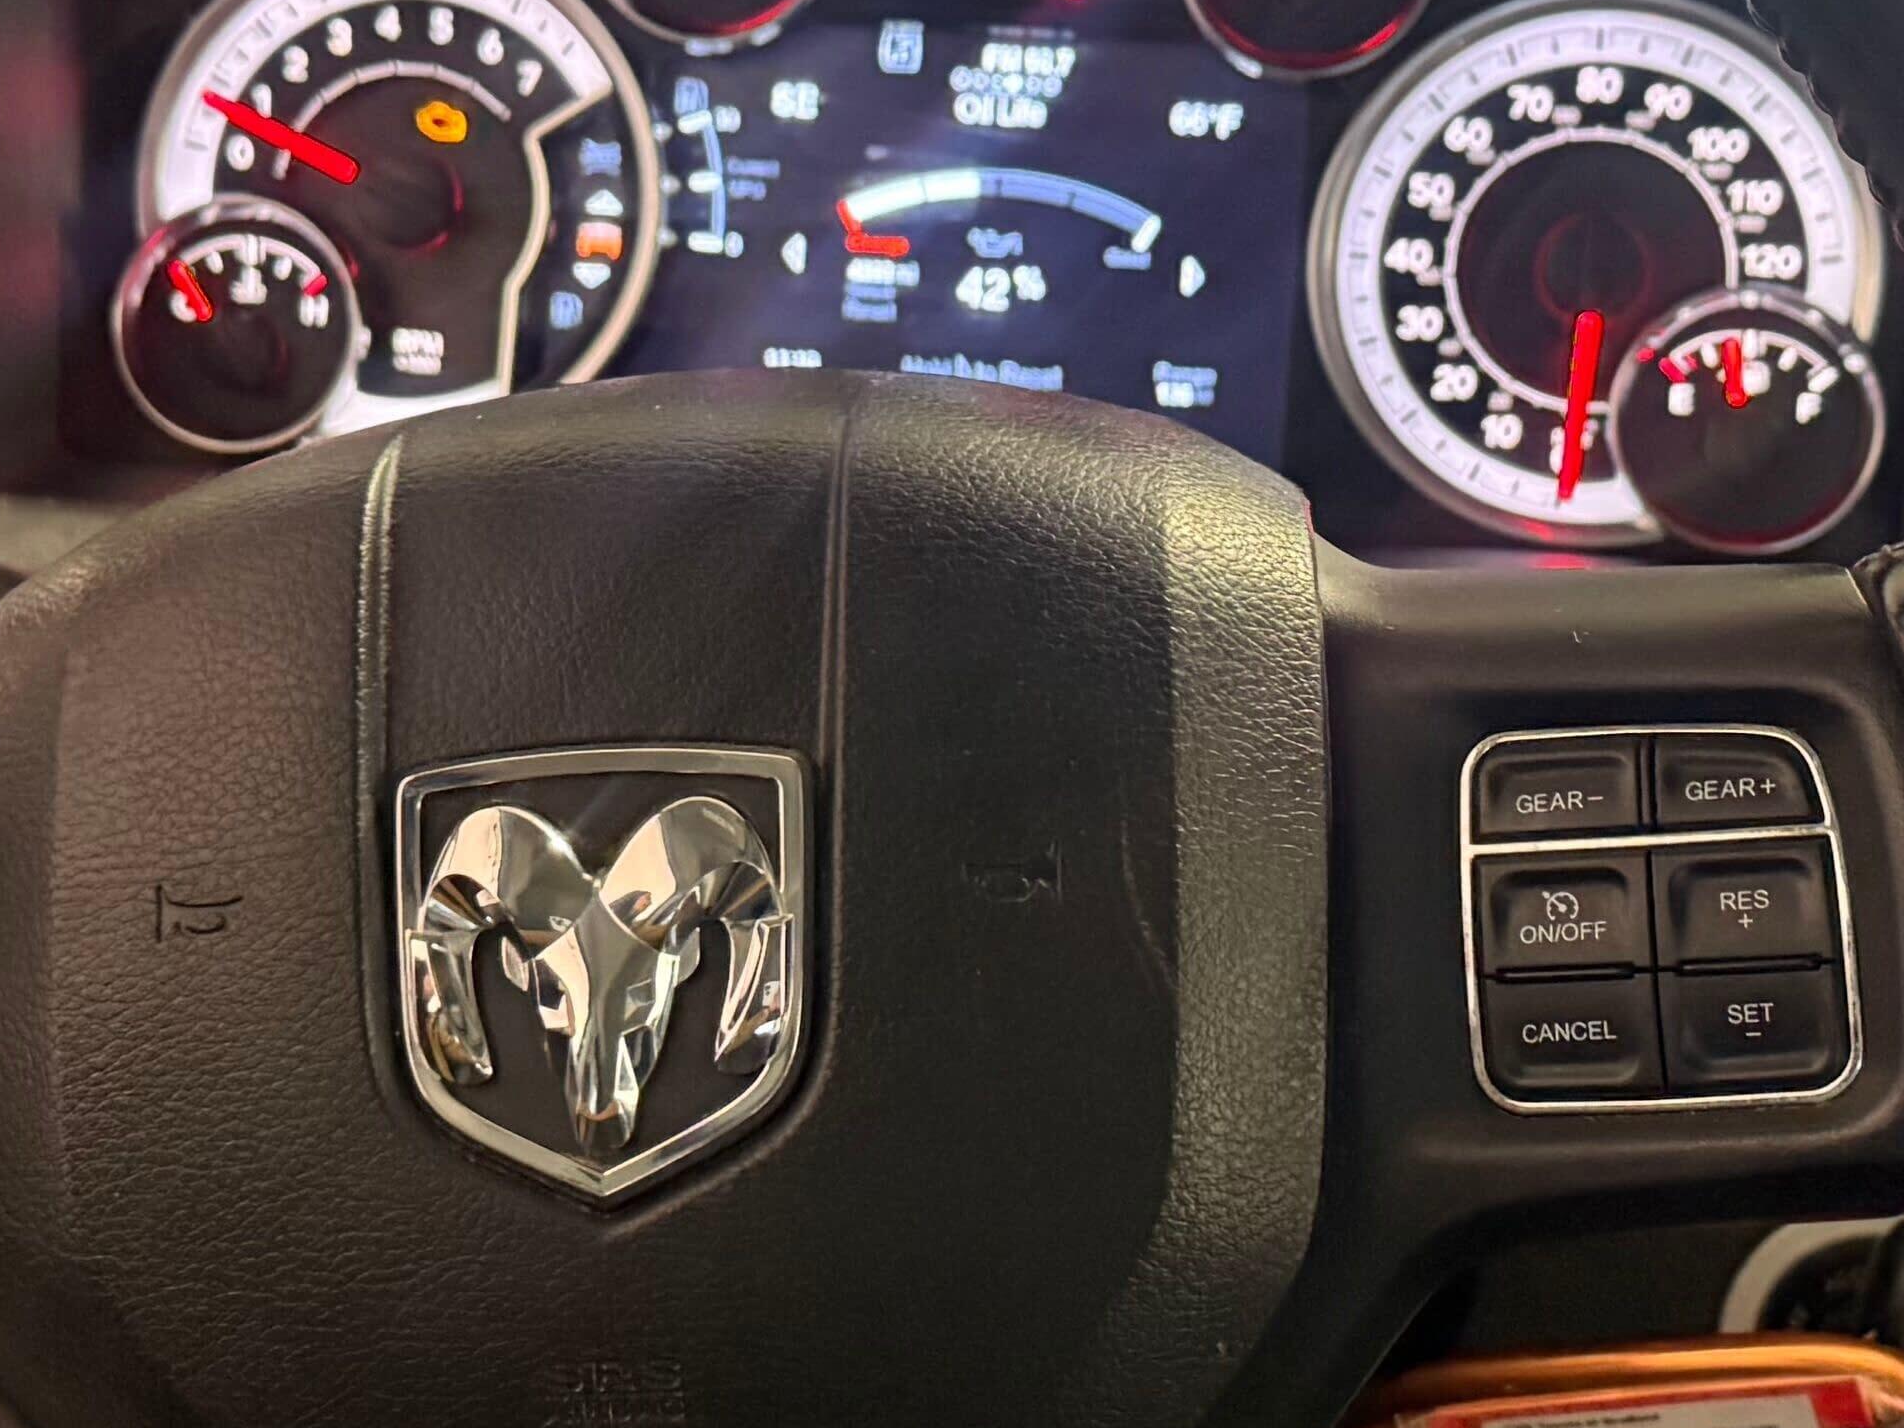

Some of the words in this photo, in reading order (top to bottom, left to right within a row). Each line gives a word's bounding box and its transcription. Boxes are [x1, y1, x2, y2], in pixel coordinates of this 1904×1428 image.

[326, 17, 353, 57] 3
[374, 4, 402, 42] 4
[428, 6, 454, 45] 5
[282, 45, 309, 83] 2
[476, 27, 505, 66] 6
[516, 59, 543, 97] 7
[1576, 65, 1624, 104] 80
[1507, 84, 1554, 122] 70
[1644, 82, 1693, 121] 90
[226, 133, 255, 171] 0
[1444, 115, 1493, 152] 60
[1687, 126, 1750, 163] 100
[1407, 171, 1455, 209] 50
[1726, 179, 1784, 216] 110
[1384, 237, 1434, 273] 40
[1740, 243, 1803, 280] 120
[1396, 304, 1444, 341] 30
[1430, 363, 1478, 401] 20
[1481, 413, 1523, 450] 10
[1719, 889, 1770, 912] RES
[1519, 921, 1607, 945] ON/OFF
[1521, 1020, 1617, 1043] CANCEL
[1727, 1002, 1774, 1025] SET
